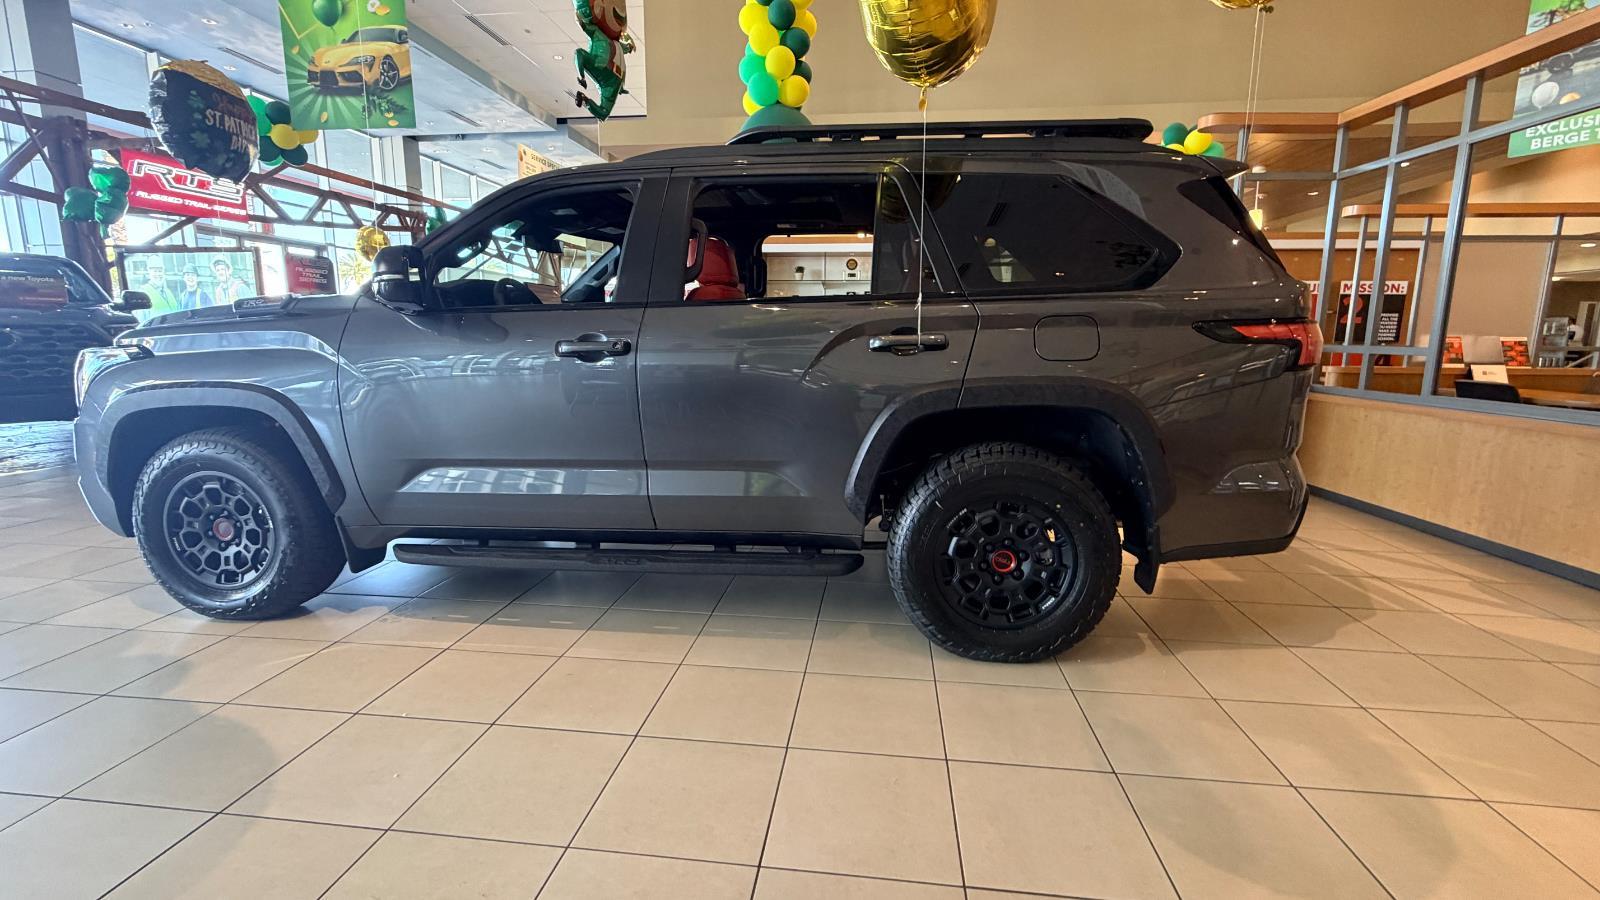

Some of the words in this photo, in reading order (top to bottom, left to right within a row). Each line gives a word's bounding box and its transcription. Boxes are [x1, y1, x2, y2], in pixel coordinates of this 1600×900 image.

[204, 108, 224, 129] ST.
[1530, 129, 1591, 150] BERGE
[132, 159, 244, 204] RTS
[136, 190, 184, 204] RUGGED
[184, 199, 212, 210] TRAIL
[212, 204, 247, 216] SERIES
[1342, 283, 1405, 294] MSSON:
